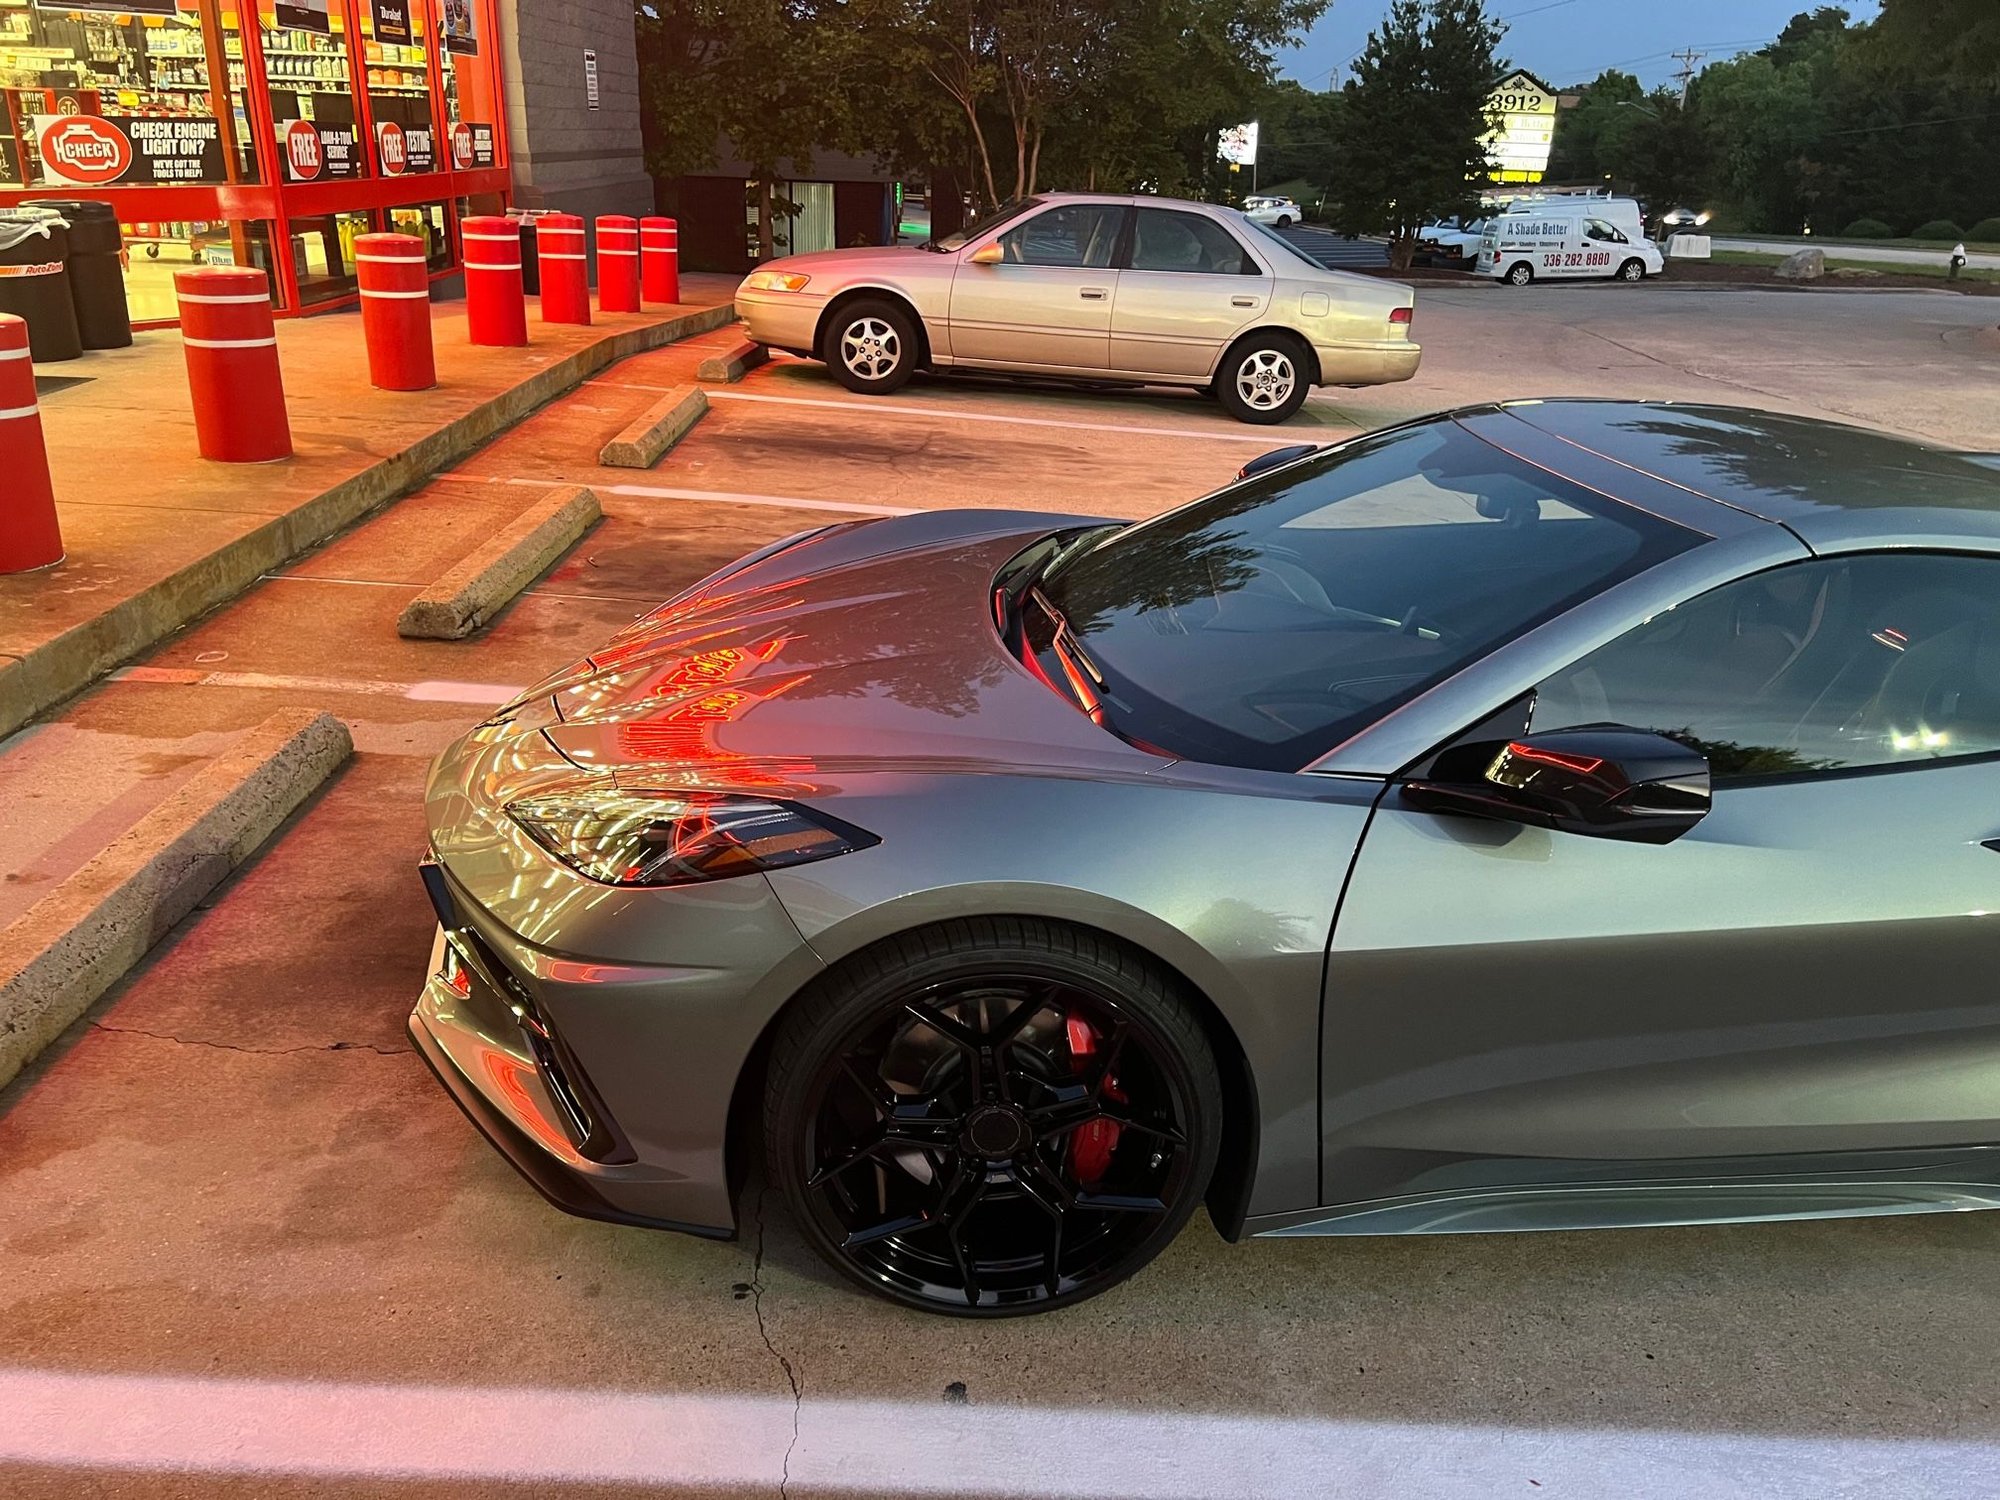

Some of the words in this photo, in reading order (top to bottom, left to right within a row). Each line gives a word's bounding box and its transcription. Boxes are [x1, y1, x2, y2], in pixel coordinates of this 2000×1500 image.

[1490, 94, 1542, 111] 3912
[130, 122, 173, 139] CHECK
[174, 122, 217, 139] ENGINE
[142, 138, 178, 155] LIGHT
[179, 139, 206, 155] ON?
[290, 132, 319, 167] FREE
[382, 133, 404, 164] FREE
[405, 130, 431, 153] TESTING
[455, 132, 472, 159] FREE
[65, 143, 112, 158] CHECK
[326, 145, 349, 159] SERVICE
[188, 159, 201, 169] THE
[153, 168, 175, 178] TOOLS
[175, 168, 184, 178] TO
[1507, 223, 1514, 236] A
[1515, 223, 1540, 236] Shade
[1542, 223, 1568, 236] Better
